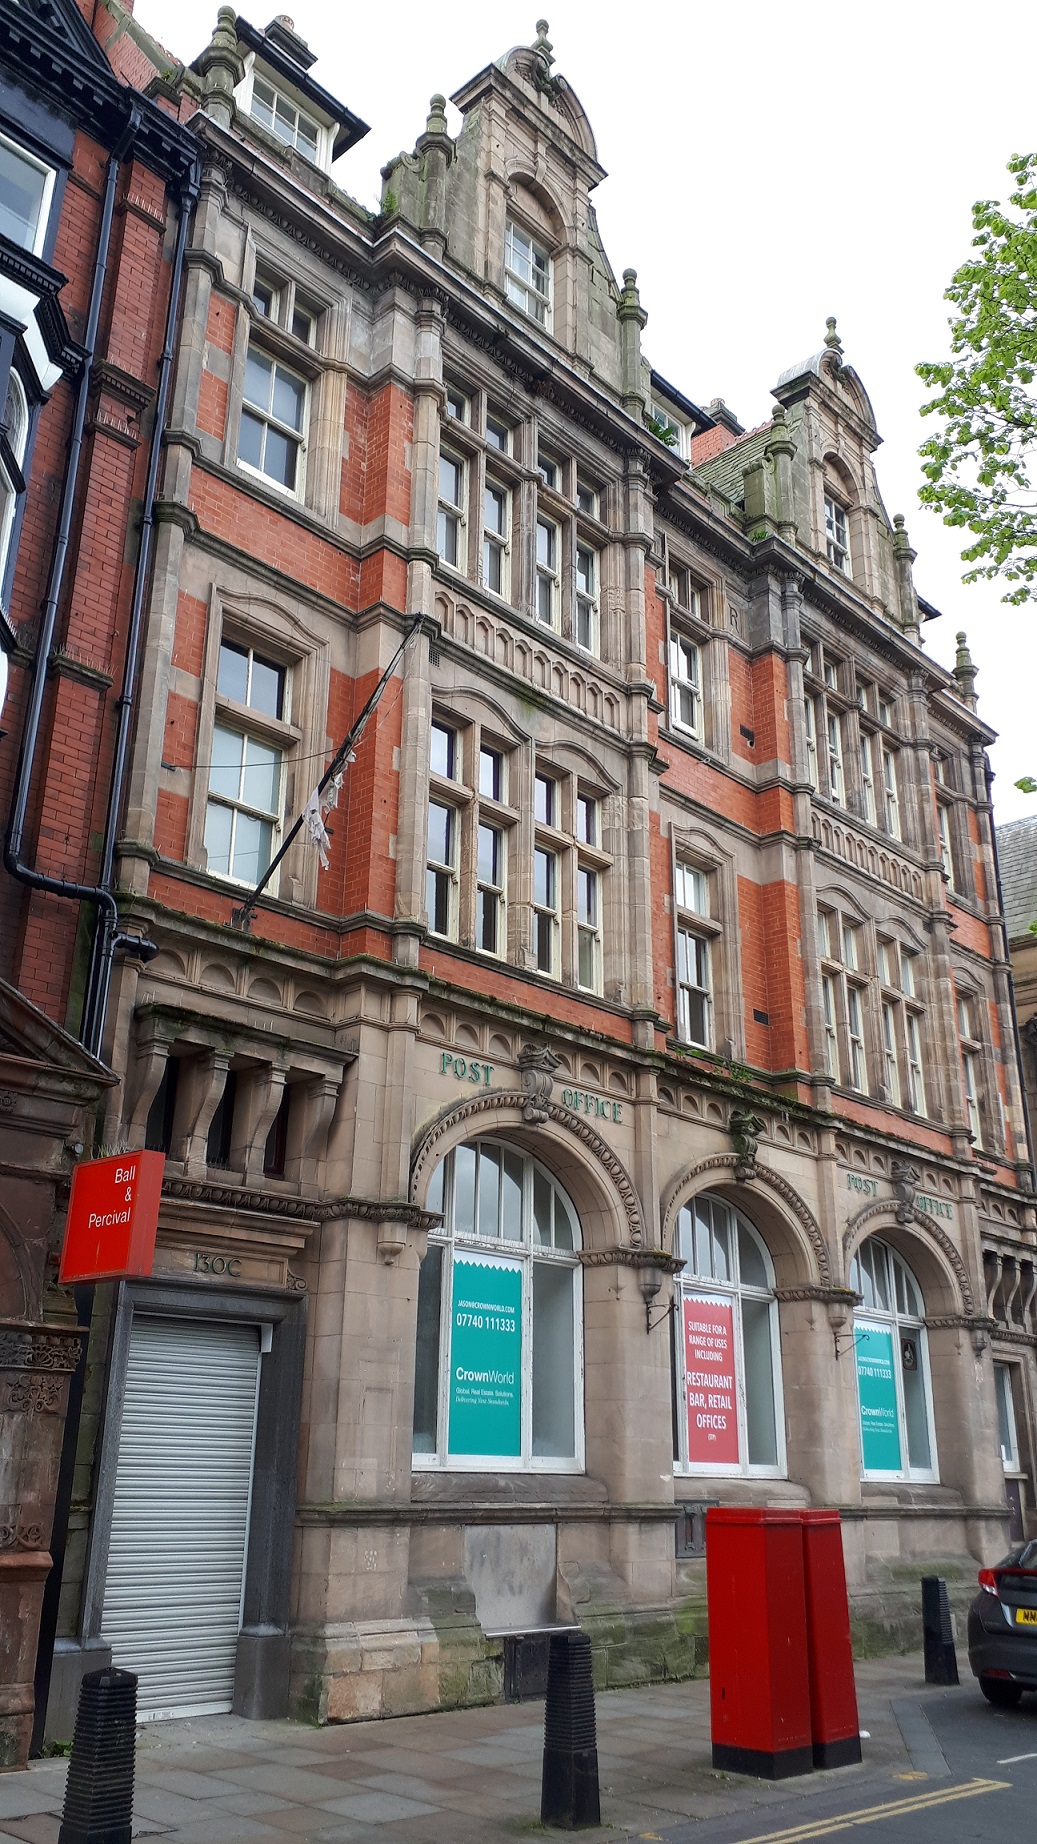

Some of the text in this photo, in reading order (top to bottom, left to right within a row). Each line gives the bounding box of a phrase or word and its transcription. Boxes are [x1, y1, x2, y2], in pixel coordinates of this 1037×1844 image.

[440, 1051, 623, 1124] POST OFFICE
[114, 1165, 136, 1184] Ball
[124, 1186, 132, 1202] &
[847, 1173, 878, 1197] POST
[88, 1207, 131, 1229] Percival
[194, 1252, 242, 1277] 130C
[456, 1312, 516, 1333] 07740 111333
[688, 1321, 711, 1334] SUITABLE
[712, 1324, 723, 1335] FOR
[688, 1334, 728, 1349] RANGE OF USES
[694, 1348, 723, 1362] INCLUDING
[455, 1366, 515, 1385] CrownWorld
[686, 1371, 733, 1390] RESTAURANT
[689, 1392, 733, 1410] BAR, RETAIL
[696, 1413, 727, 1430] OFFICES
